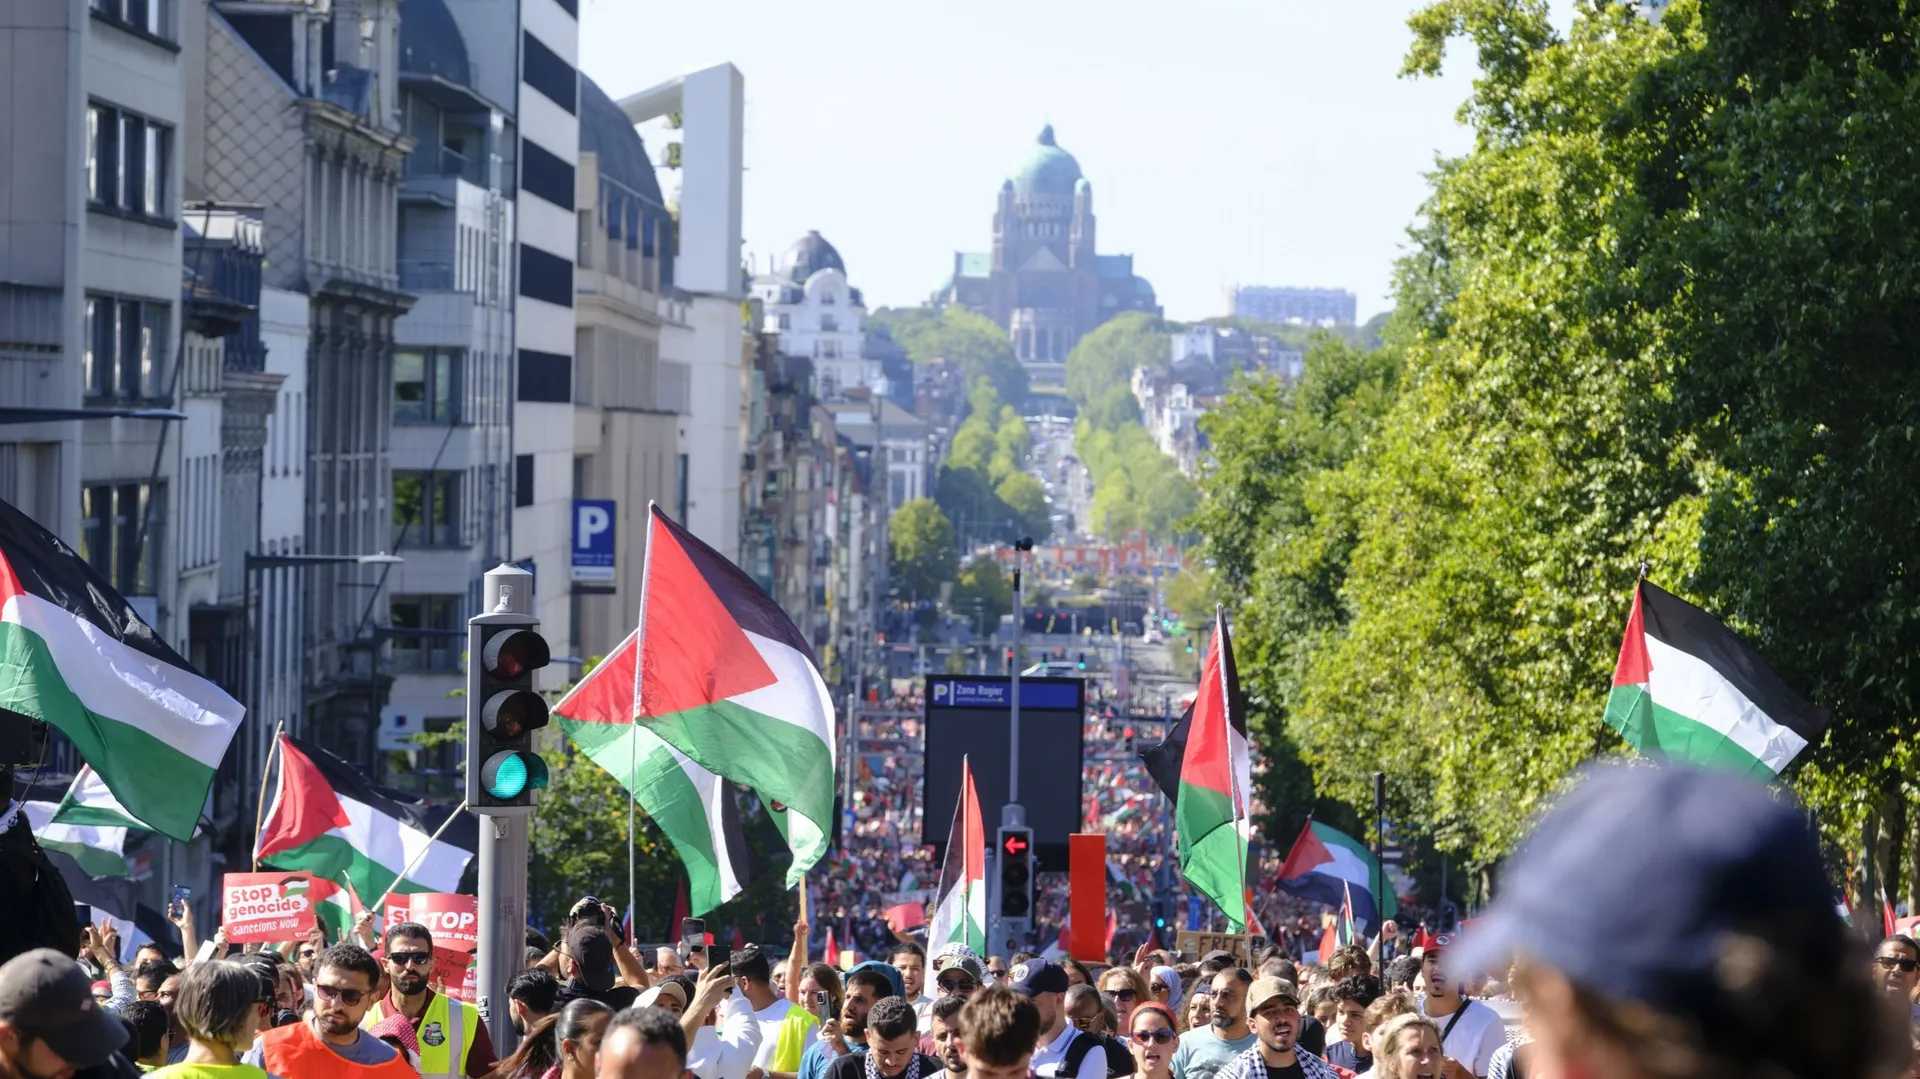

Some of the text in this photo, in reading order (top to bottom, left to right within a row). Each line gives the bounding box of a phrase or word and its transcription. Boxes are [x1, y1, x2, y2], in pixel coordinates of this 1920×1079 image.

[578, 506, 610, 549] P
[934, 684, 948, 701] P
[956, 684, 976, 695] Zone
[230, 887, 272, 904] Stop
[229, 898, 301, 920] genocide
[232, 921, 277, 936] sanctions
[463, 933, 479, 942] GAZ
[1198, 935, 1245, 961] FREE
